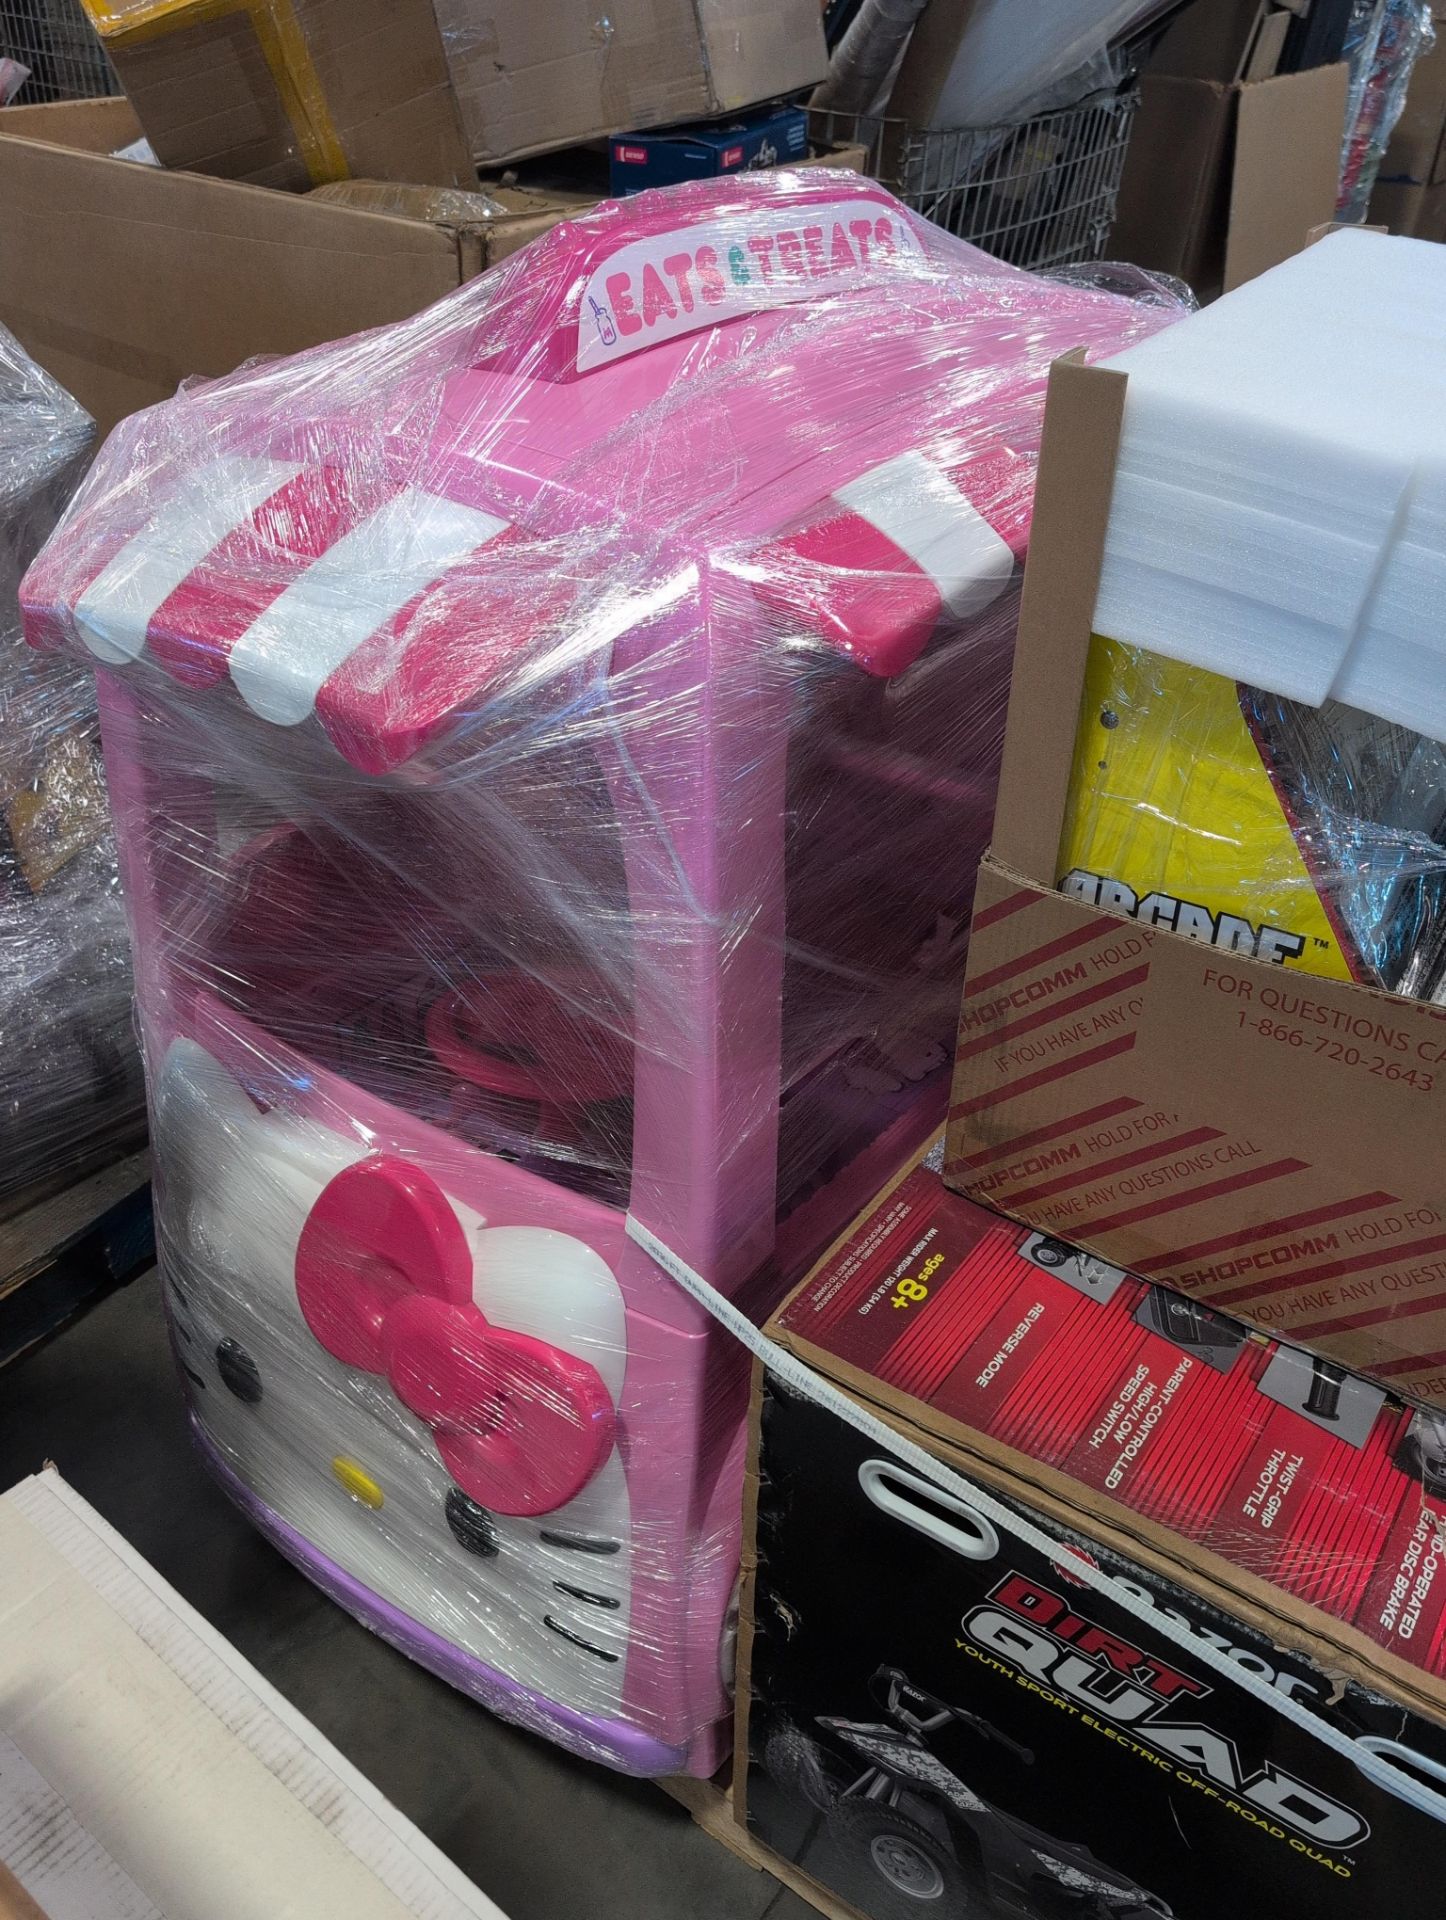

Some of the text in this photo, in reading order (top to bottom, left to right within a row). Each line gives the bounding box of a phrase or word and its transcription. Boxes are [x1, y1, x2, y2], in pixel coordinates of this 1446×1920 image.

[606, 246, 726, 336] EATS
[748, 217, 897, 286] TREATS
[959, 961, 1089, 1034] HOPCOMM
[1089, 939, 1142, 971] HOLD
[1202, 968, 1254, 1000] FOR
[1260, 987, 1411, 1052] QUESTIONS
[994, 1055, 1010, 1073] IF
[1008, 1040, 1046, 1066] YOU
[1044, 1022, 1093, 1052] HAVE
[1091, 1006, 1127, 1033] ANY
[1238, 1011, 1434, 1092] 1-866-720-2643
[1083, 1124, 1133, 1153] HOLD
[1131, 1111, 1172, 1136] FOR
[1041, 1200, 1083, 1223] HAVE
[1084, 1185, 1117, 1209] ANY
[1118, 1153, 1215, 1195] QUESTIONS
[1213, 1140, 1263, 1165] CALL
[839, 1260, 861, 1284] PRODUCT
[857, 1226, 938, 1315] MAX RIDER WEIGHT 120 LB (54 KG)
[890, 1253, 945, 1308] ages 8+
[1180, 1233, 1341, 1290] SHOPCOMM
[1343, 1216, 1403, 1244] HOLD
[811, 1282, 832, 1304] CHANGE
[814, 1281, 842, 1312] DECORATION
[1244, 1303, 1285, 1322] YOU
[1287, 1289, 1336, 1314] HAVE
[1340, 1280, 1377, 1302] ANY
[975, 1302, 1045, 1388] REVERSE MODE
[1089, 1364, 1149, 1448] SPEED SWITCH
[1105, 1356, 1193, 1489] PARENT-CONTROLLED
[1113, 1382, 1158, 1444] HIGH/LOW
[1242, 1449, 1286, 1518] THROTTLE
[1261, 1454, 1304, 1528] TWIST-GRIP
[1400, 1539, 1423, 1577] DISC
[990, 1573, 1206, 1698] DIRT
[1380, 1573, 1410, 1631] BRAKE
[954, 1638, 1352, 1878] YOUTH SPORT ELECTRIC OFF-ROAD QUAD
[967, 1609, 1362, 1843] QUAD
